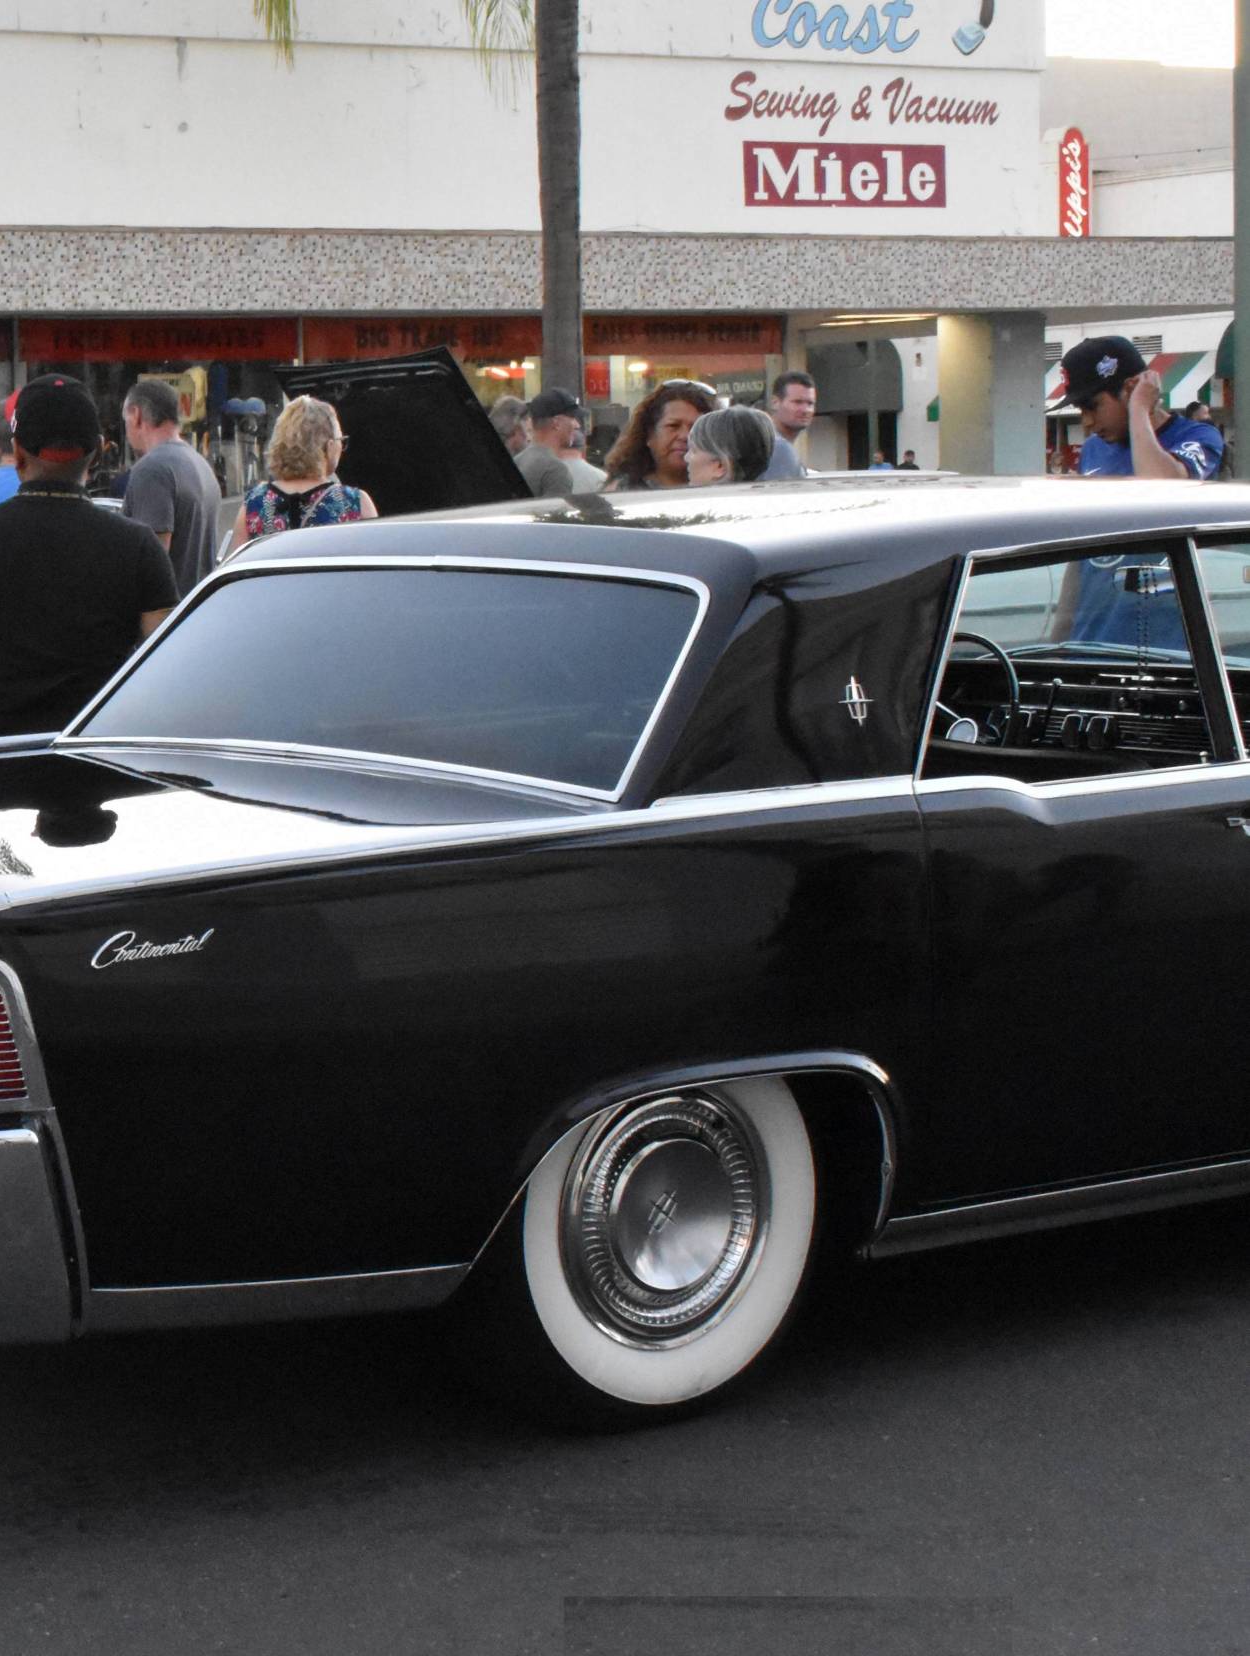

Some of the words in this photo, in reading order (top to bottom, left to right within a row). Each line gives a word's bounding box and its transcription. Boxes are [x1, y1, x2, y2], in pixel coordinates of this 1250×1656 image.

[751, 0, 920, 54] Coast
[724, 70, 842, 137] Sewing
[851, 85, 872, 122] &
[882, 76, 1000, 126] Vacuum
[752, 147, 938, 203] Miele
[90, 928, 215, 969] Continental
